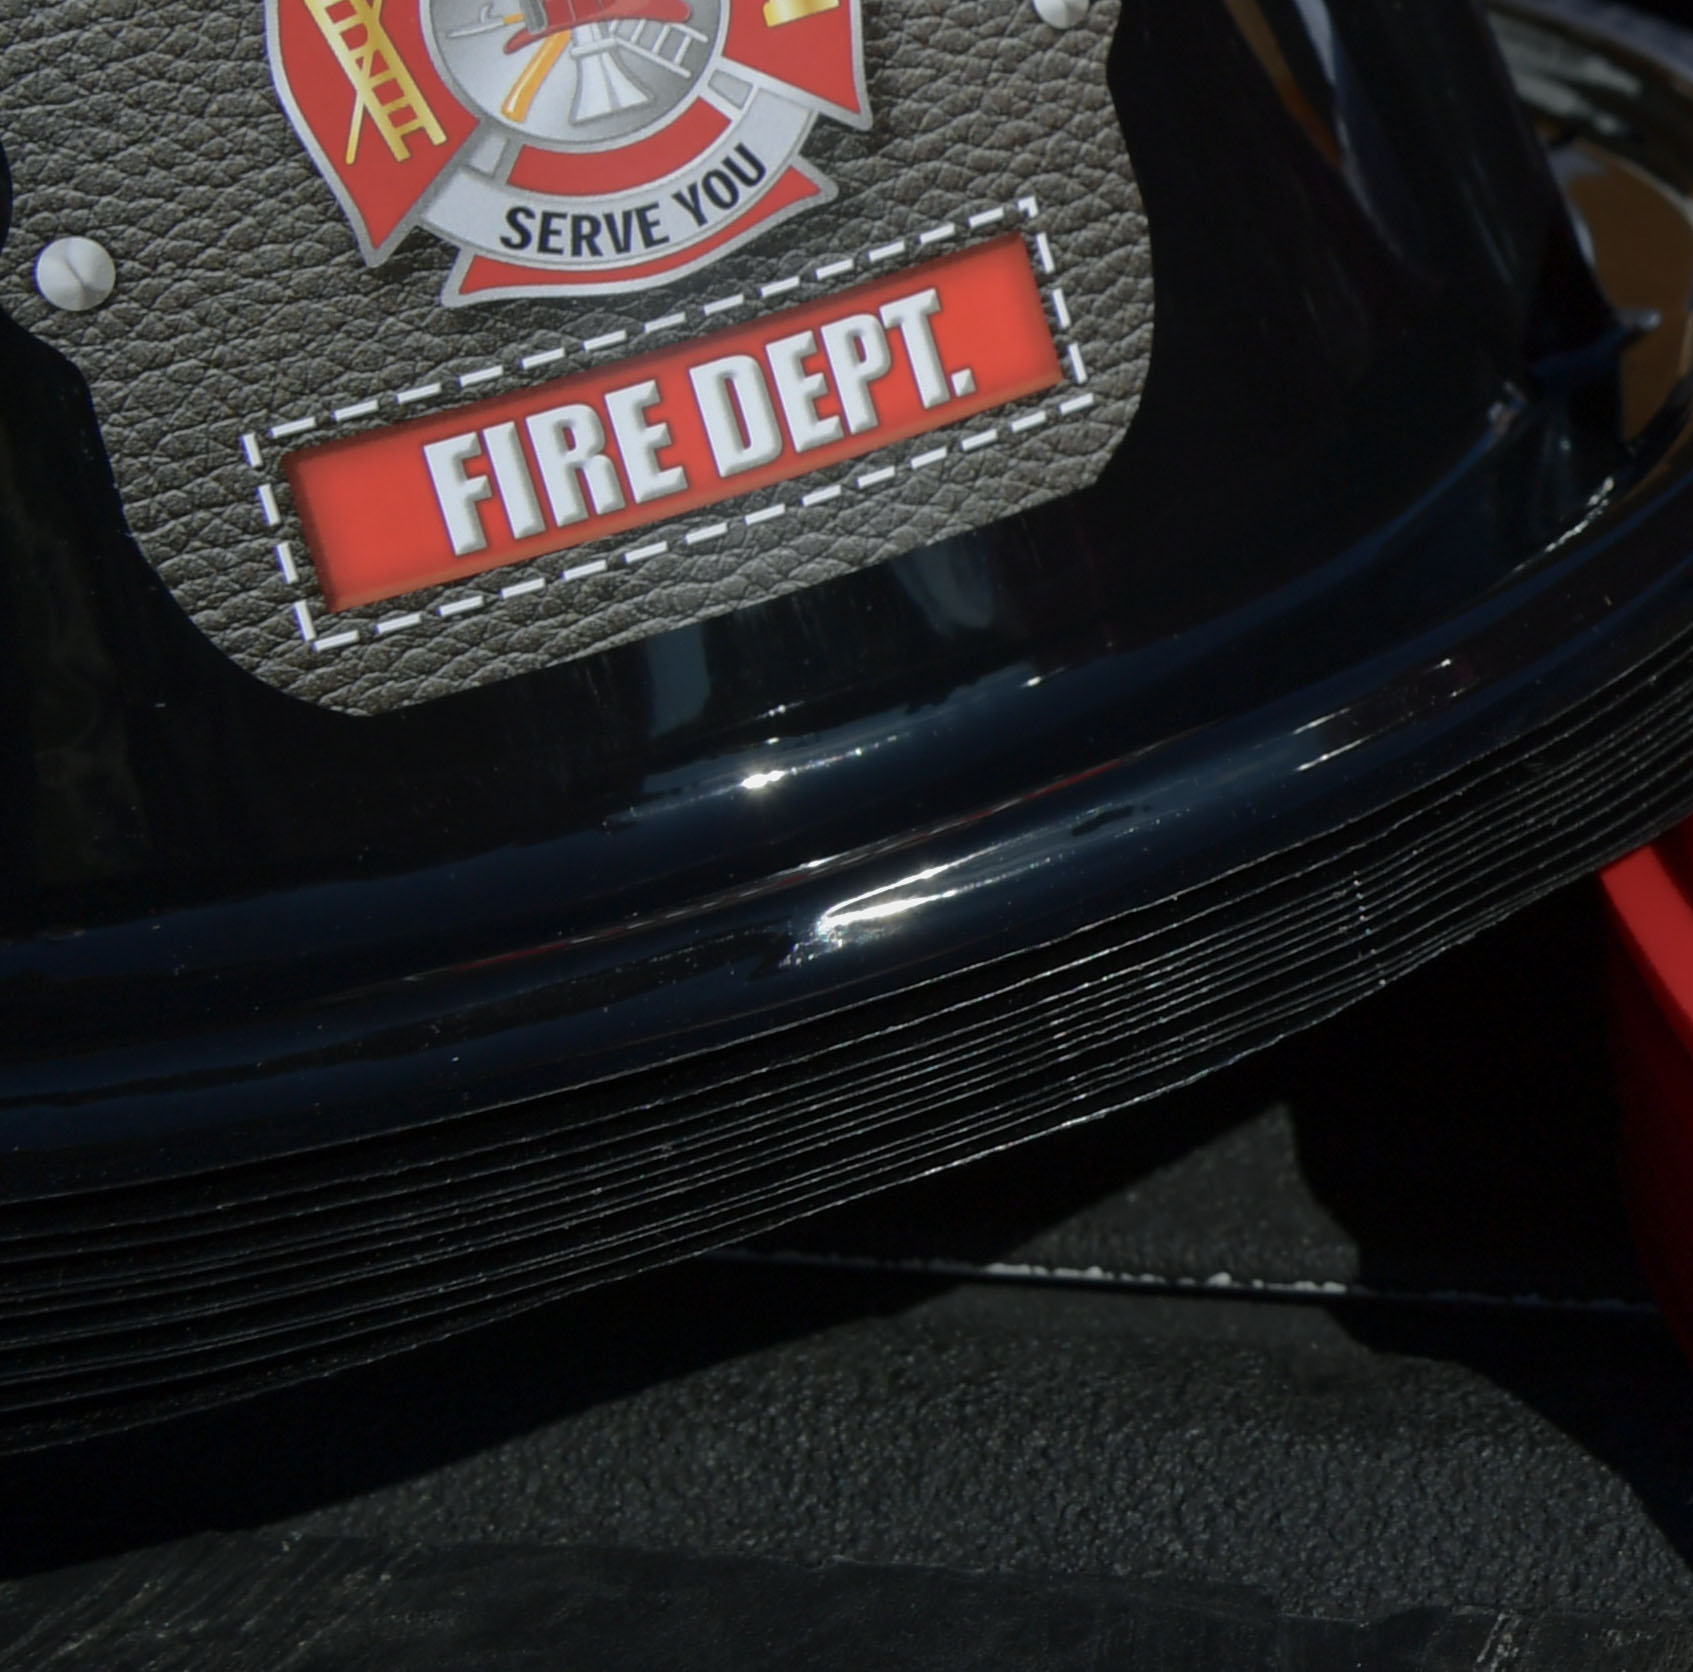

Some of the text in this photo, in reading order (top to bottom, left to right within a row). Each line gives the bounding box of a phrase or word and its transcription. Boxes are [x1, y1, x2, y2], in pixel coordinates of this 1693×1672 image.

[500, 142, 768, 259] SERVE YOU
[423, 289, 974, 557] FIRE DEPT.
